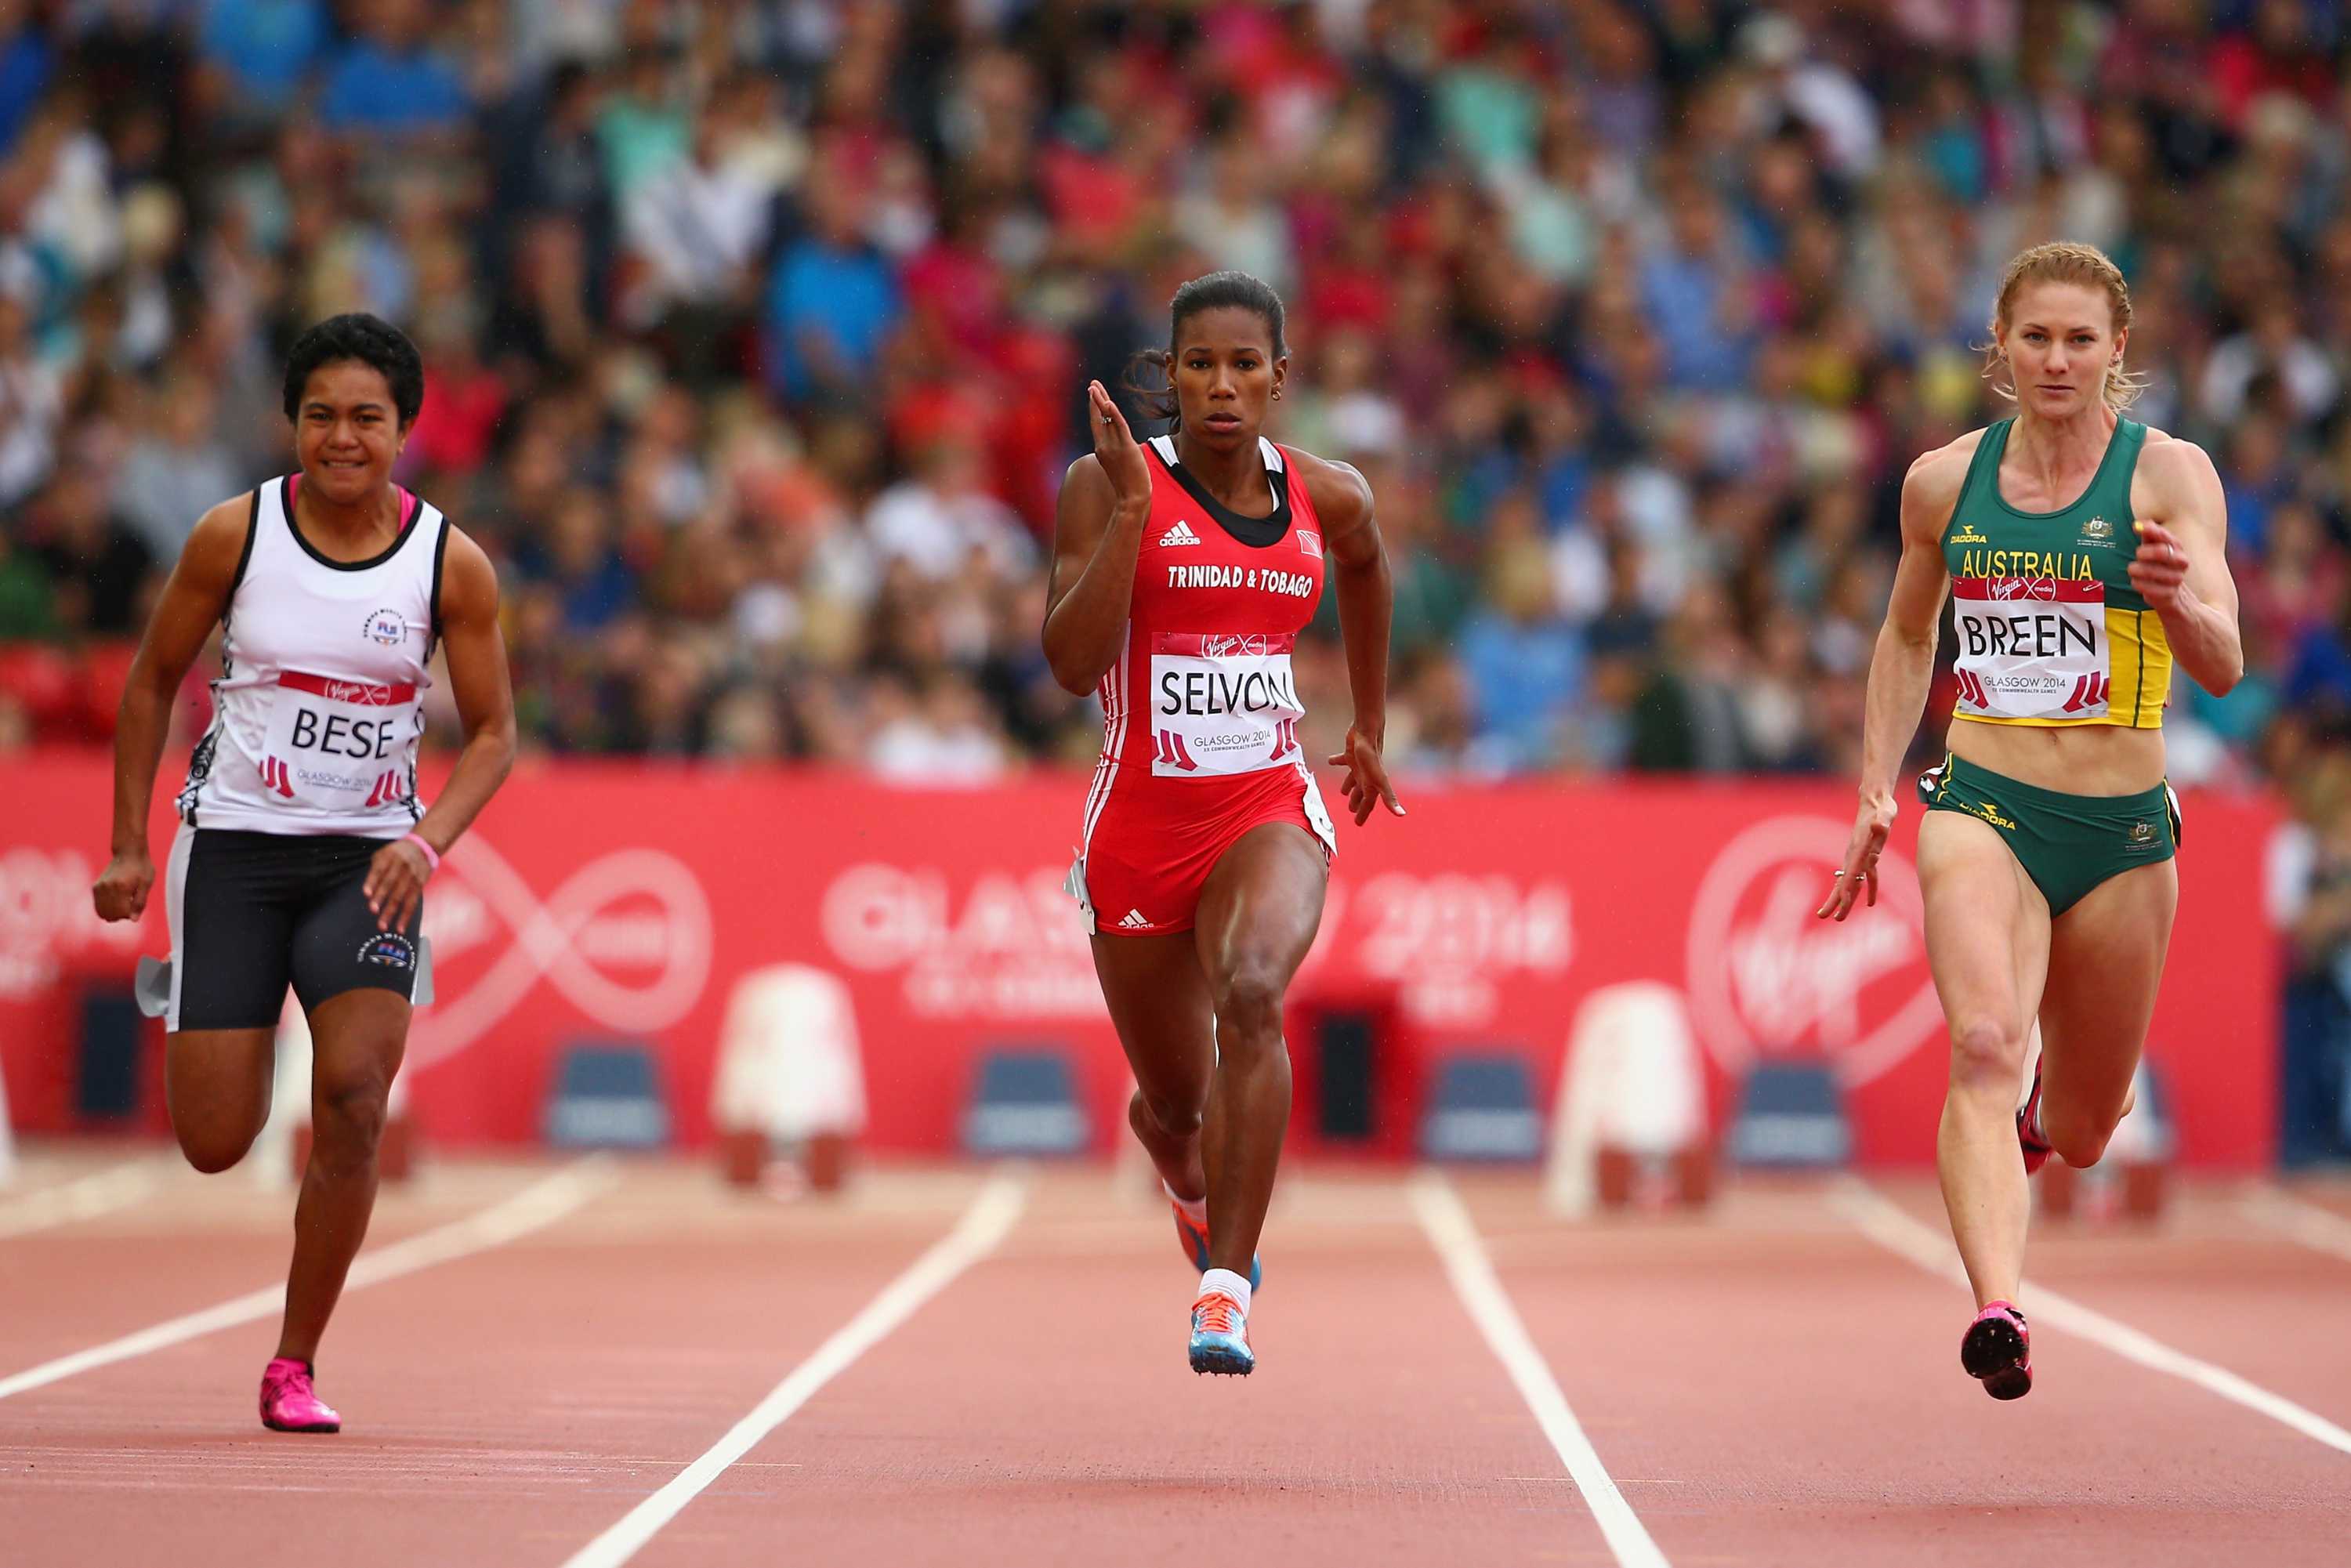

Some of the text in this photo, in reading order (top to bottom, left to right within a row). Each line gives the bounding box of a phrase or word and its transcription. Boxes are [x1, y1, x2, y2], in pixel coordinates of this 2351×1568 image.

[1159, 535, 1201, 547] adidas
[1962, 550, 2094, 581] AUSTRALIA
[1168, 565, 1313, 599] TRINIDAD & TOBAGO
[1992, 578, 2022, 600] Virgin
[1207, 634, 1238, 658] Virgin
[1962, 614, 2096, 657] BREEN
[1161, 671, 1297, 716] SELVON
[1983, 676, 2067, 688] GLASGOW 2014
[292, 708, 394, 760] BESE
[1194, 730, 1271, 747] GLASGOW 2014
